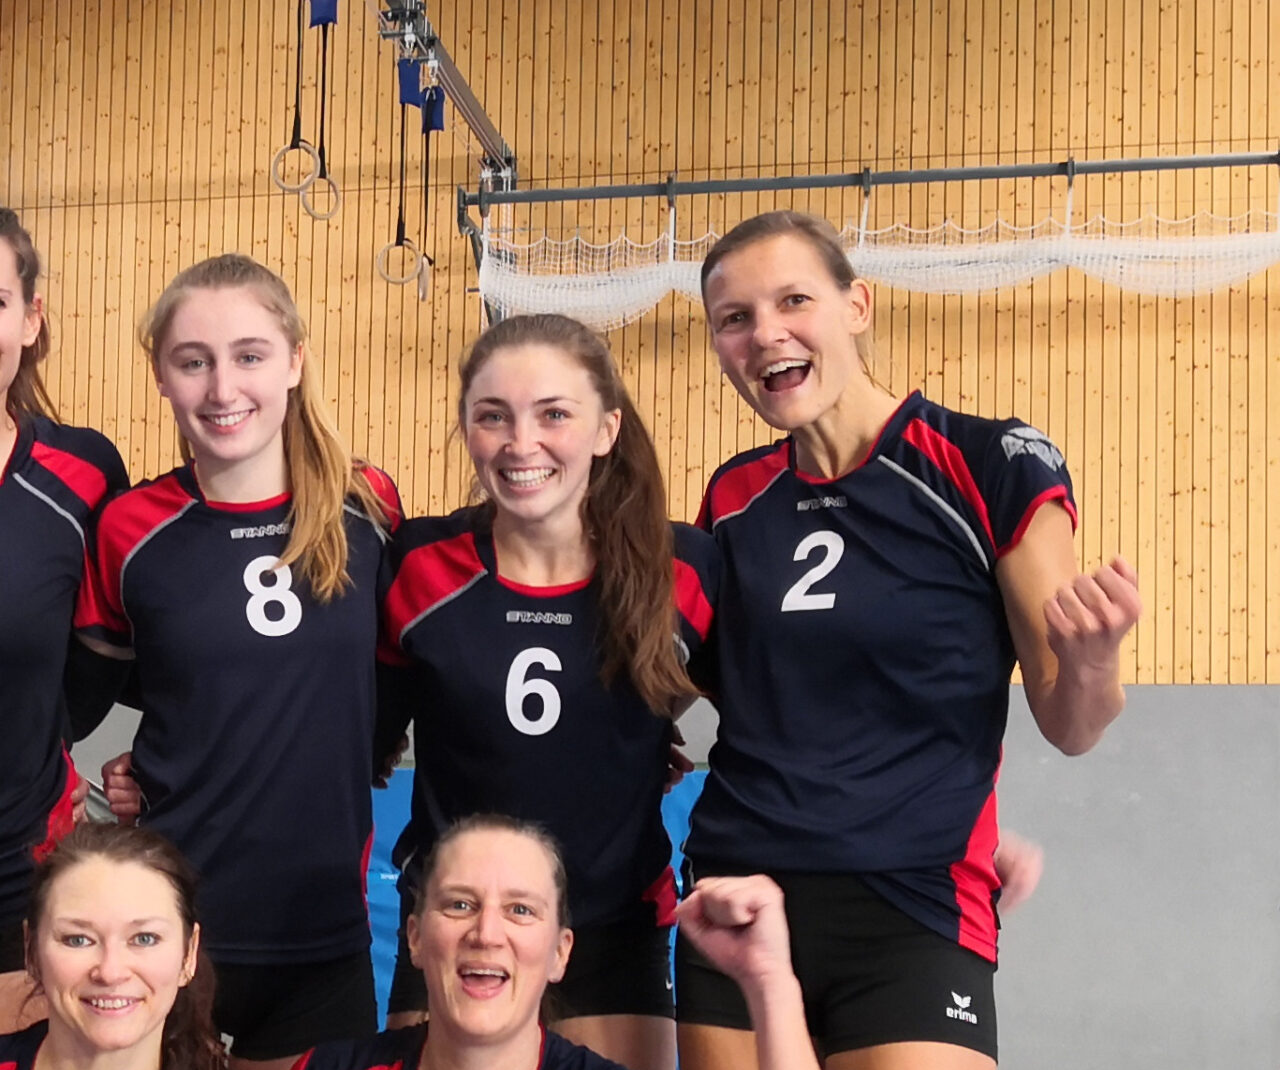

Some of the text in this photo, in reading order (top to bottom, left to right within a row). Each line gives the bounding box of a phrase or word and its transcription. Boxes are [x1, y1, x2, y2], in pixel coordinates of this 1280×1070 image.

[243, 555, 302, 636] 8
[782, 531, 844, 611] 2
[506, 611, 572, 625] STANNO
[505, 647, 562, 736] 6
[946, 1007, 977, 1024] erima
